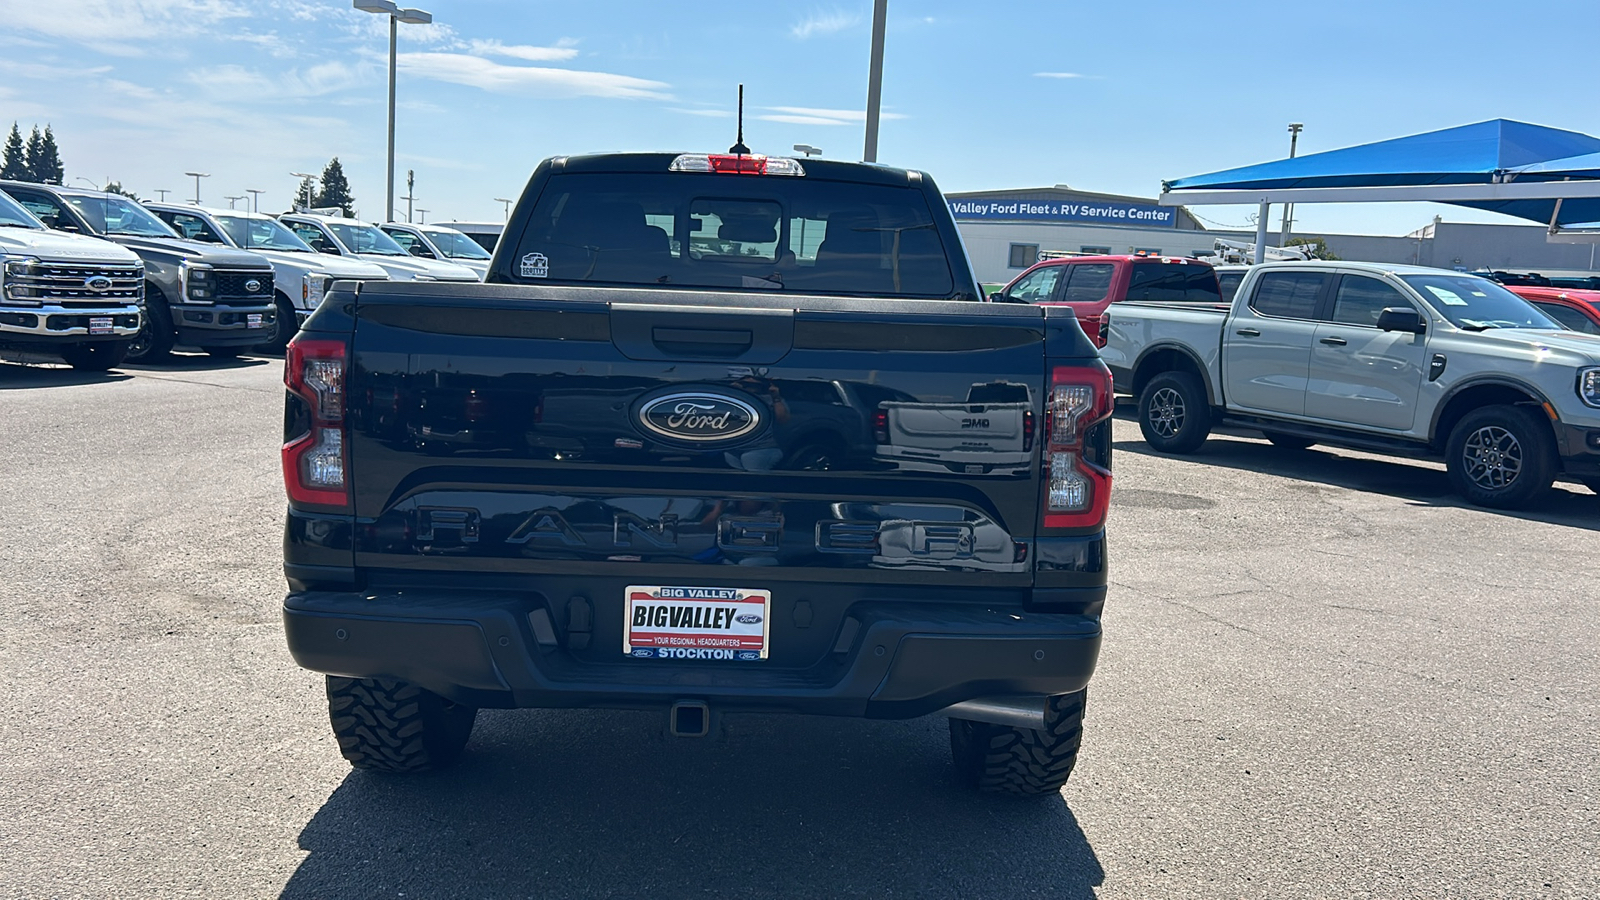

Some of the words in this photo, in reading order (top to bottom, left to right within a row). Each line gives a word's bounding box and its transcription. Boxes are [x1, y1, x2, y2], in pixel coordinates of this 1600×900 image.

[953, 203, 988, 215] Valley
[990, 203, 1017, 214] Ford
[1019, 204, 1050, 214] Fleet
[1060, 205, 1079, 215] RV
[1080, 205, 1126, 218] Service
[1128, 208, 1171, 220] Center
[667, 402, 731, 430] Ford
[416, 506, 977, 555] RANGER
[661, 589, 684, 597] BIG
[688, 590, 736, 599] VALLEY
[633, 605, 737, 629] BIGVALLEY
[670, 637, 696, 646] REGIONAL
[698, 638, 740, 647] HEADQUARTERS
[659, 648, 734, 660] STOCKTON
